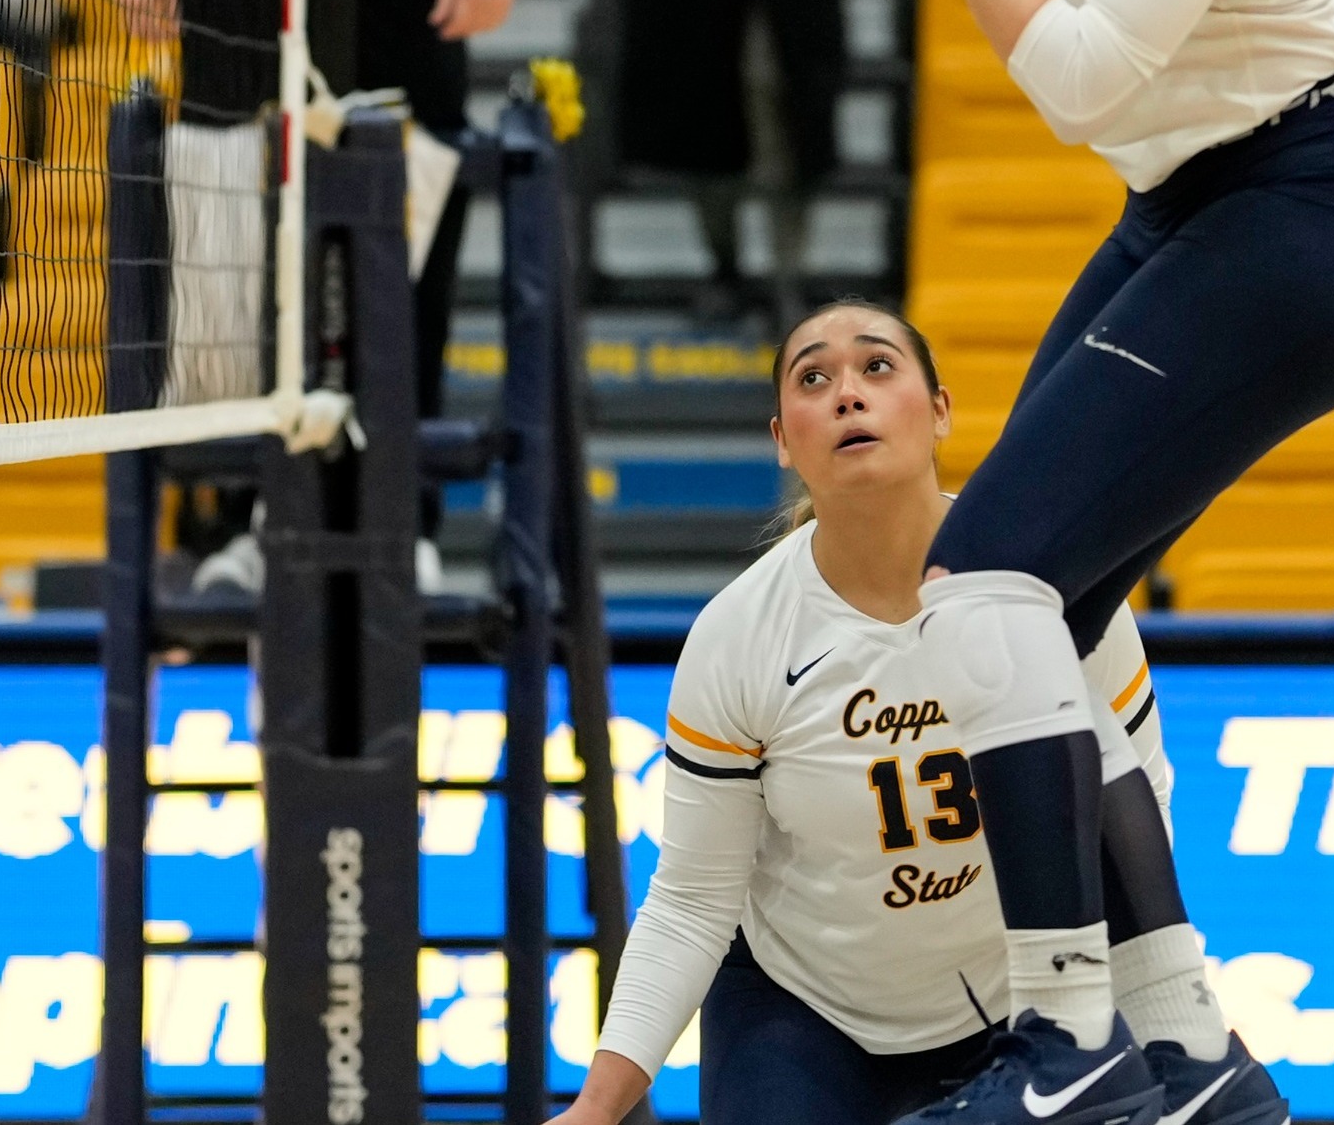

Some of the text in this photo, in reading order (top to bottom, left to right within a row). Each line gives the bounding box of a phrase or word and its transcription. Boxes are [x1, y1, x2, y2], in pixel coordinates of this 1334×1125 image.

[842, 687, 950, 745] Copp
[867, 747, 984, 854] 13
[319, 826, 367, 961] sports
